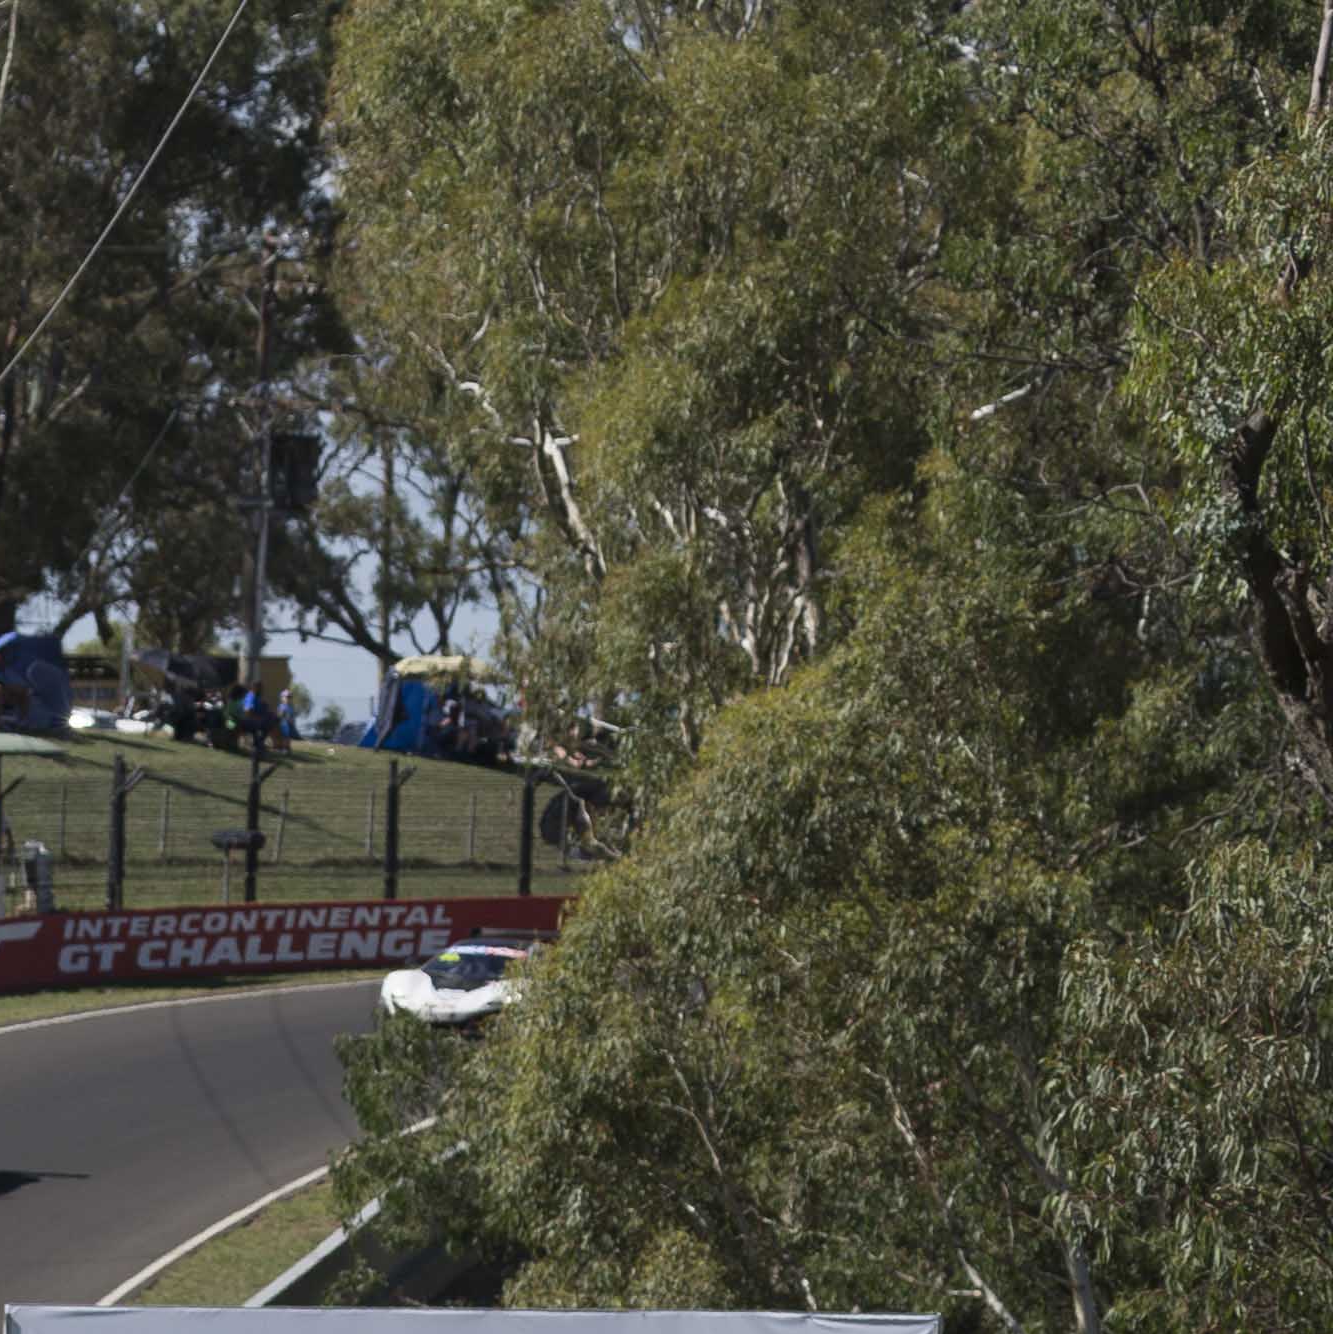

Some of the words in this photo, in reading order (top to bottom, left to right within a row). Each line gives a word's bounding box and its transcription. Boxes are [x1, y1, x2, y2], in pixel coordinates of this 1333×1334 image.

[64, 904, 452, 938] INTERCONTINENTAL
[58, 942, 126, 973] GT
[136, 928, 451, 970] CHALLENGE
